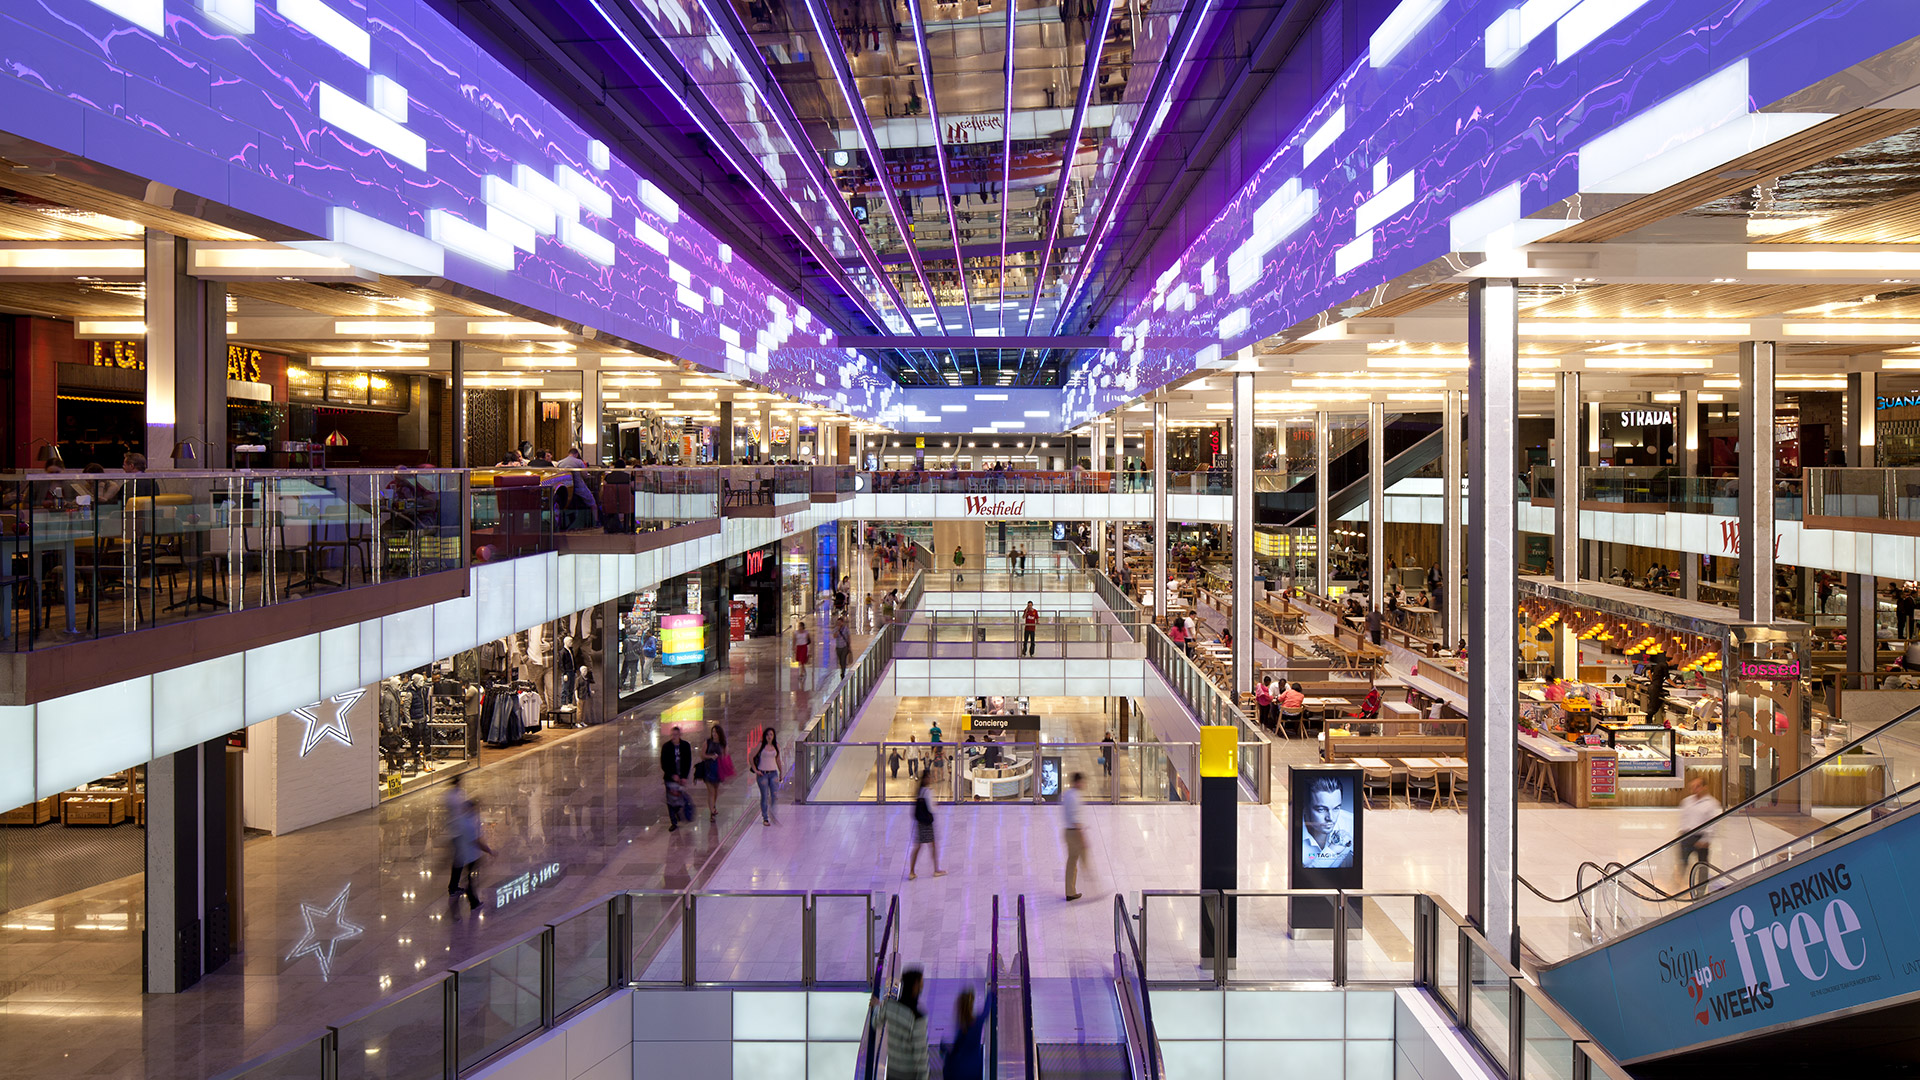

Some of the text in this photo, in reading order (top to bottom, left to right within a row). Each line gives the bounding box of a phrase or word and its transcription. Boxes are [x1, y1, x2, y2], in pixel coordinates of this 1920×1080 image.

[1621, 410, 1672, 427] STRADA
[964, 495, 1025, 516] Westfield
[1741, 660, 1800, 676] tossed
[973, 719, 1009, 732] Concierge
[1768, 863, 1852, 917] PARKING
[1729, 899, 1867, 999] free
[1658, 946, 1700, 988] Sign
[1709, 981, 1774, 1022] WEEKS
